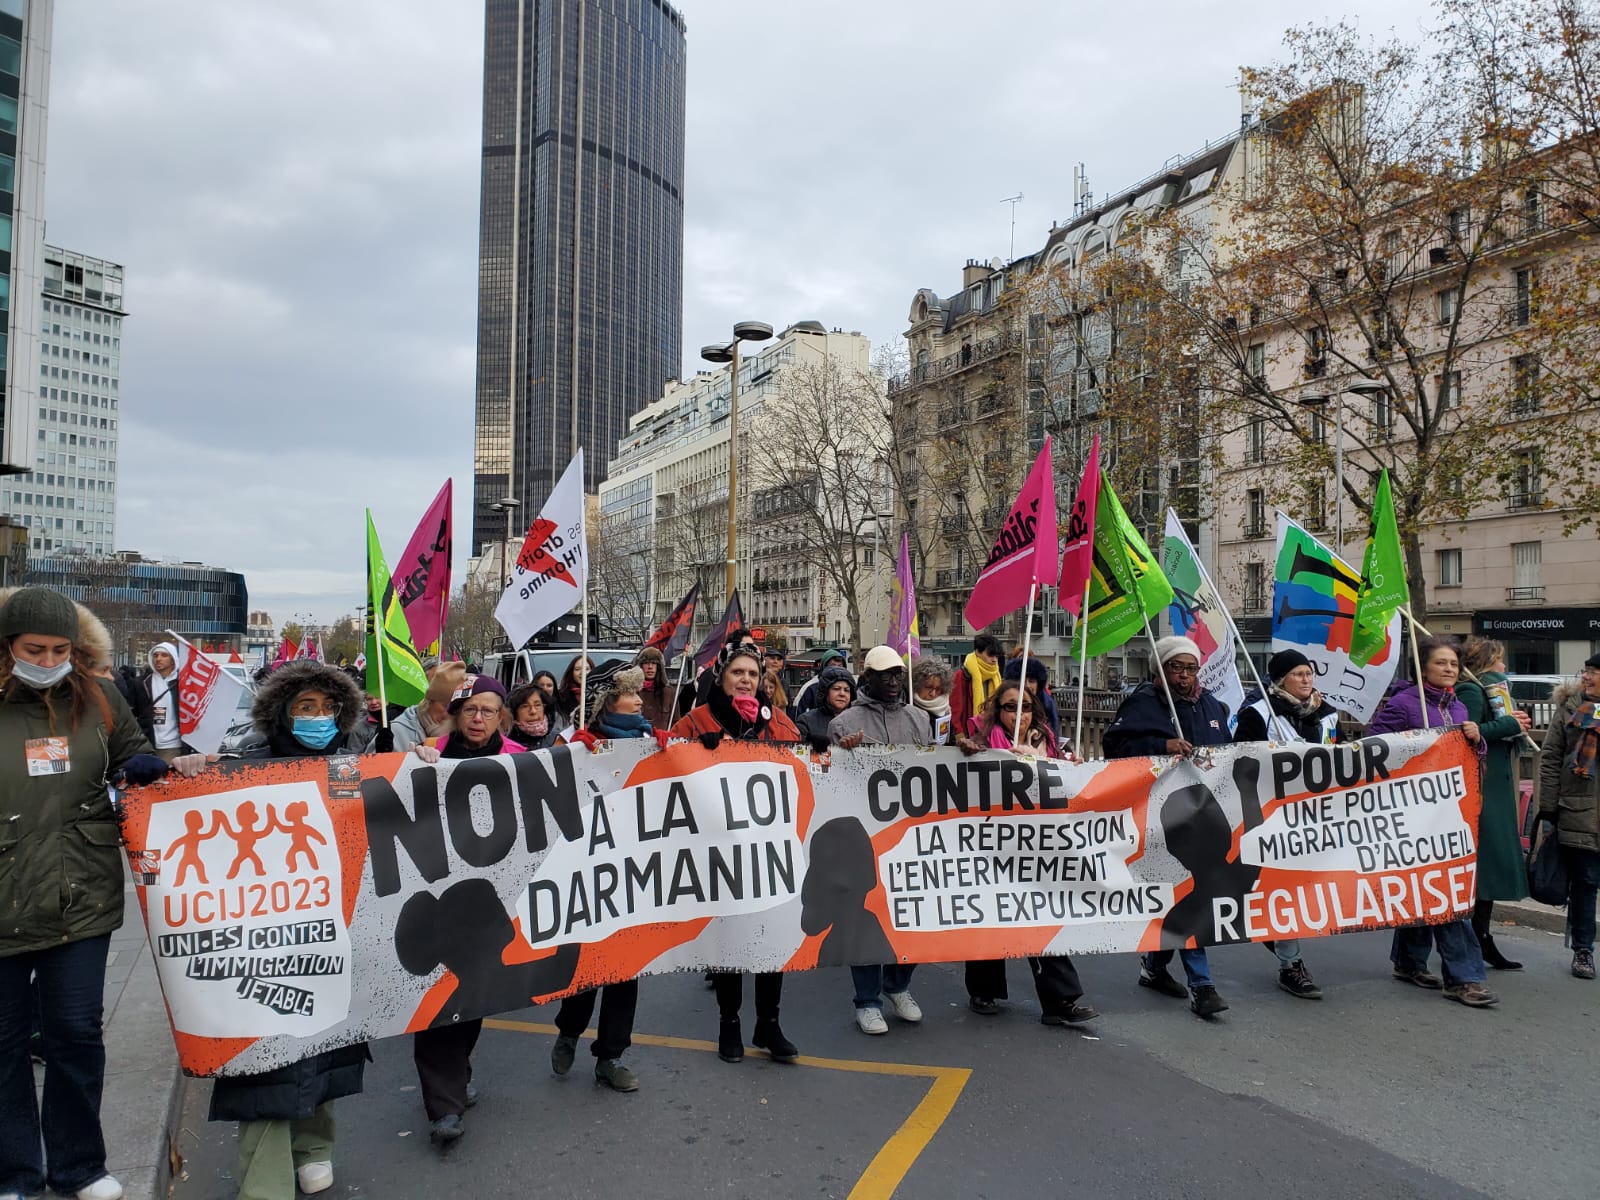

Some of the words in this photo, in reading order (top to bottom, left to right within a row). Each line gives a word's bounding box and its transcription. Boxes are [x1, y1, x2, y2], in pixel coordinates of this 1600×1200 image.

[867, 759, 1068, 823] CONTRE
[1271, 738, 1390, 800] POUR
[361, 744, 585, 898] NON
[587, 779, 616, 856] À
[636, 781, 699, 842] LA
[719, 770, 791, 831] LOI
[1282, 795, 1334, 829] UNE
[1345, 769, 1463, 818] POLITIQUE
[915, 825, 947, 856] LA
[958, 814, 1136, 852] RÉPRESSION,
[1258, 812, 1410, 863] MIGRATOIRE
[1355, 828, 1472, 873] D'ACCUEIL
[527, 839, 796, 944] DARMANIN
[888, 851, 1107, 893] L'ENFERMEMENT
[163, 875, 331, 928] UCIJ2023
[894, 896, 925, 928] ET
[937, 893, 984, 926] LES
[995, 885, 1165, 923] EXPULSIONS
[250, 919, 334, 949] CONTRE
[188, 954, 343, 977] L'IMMIGRATION
[238, 977, 313, 1016] JETABLE
